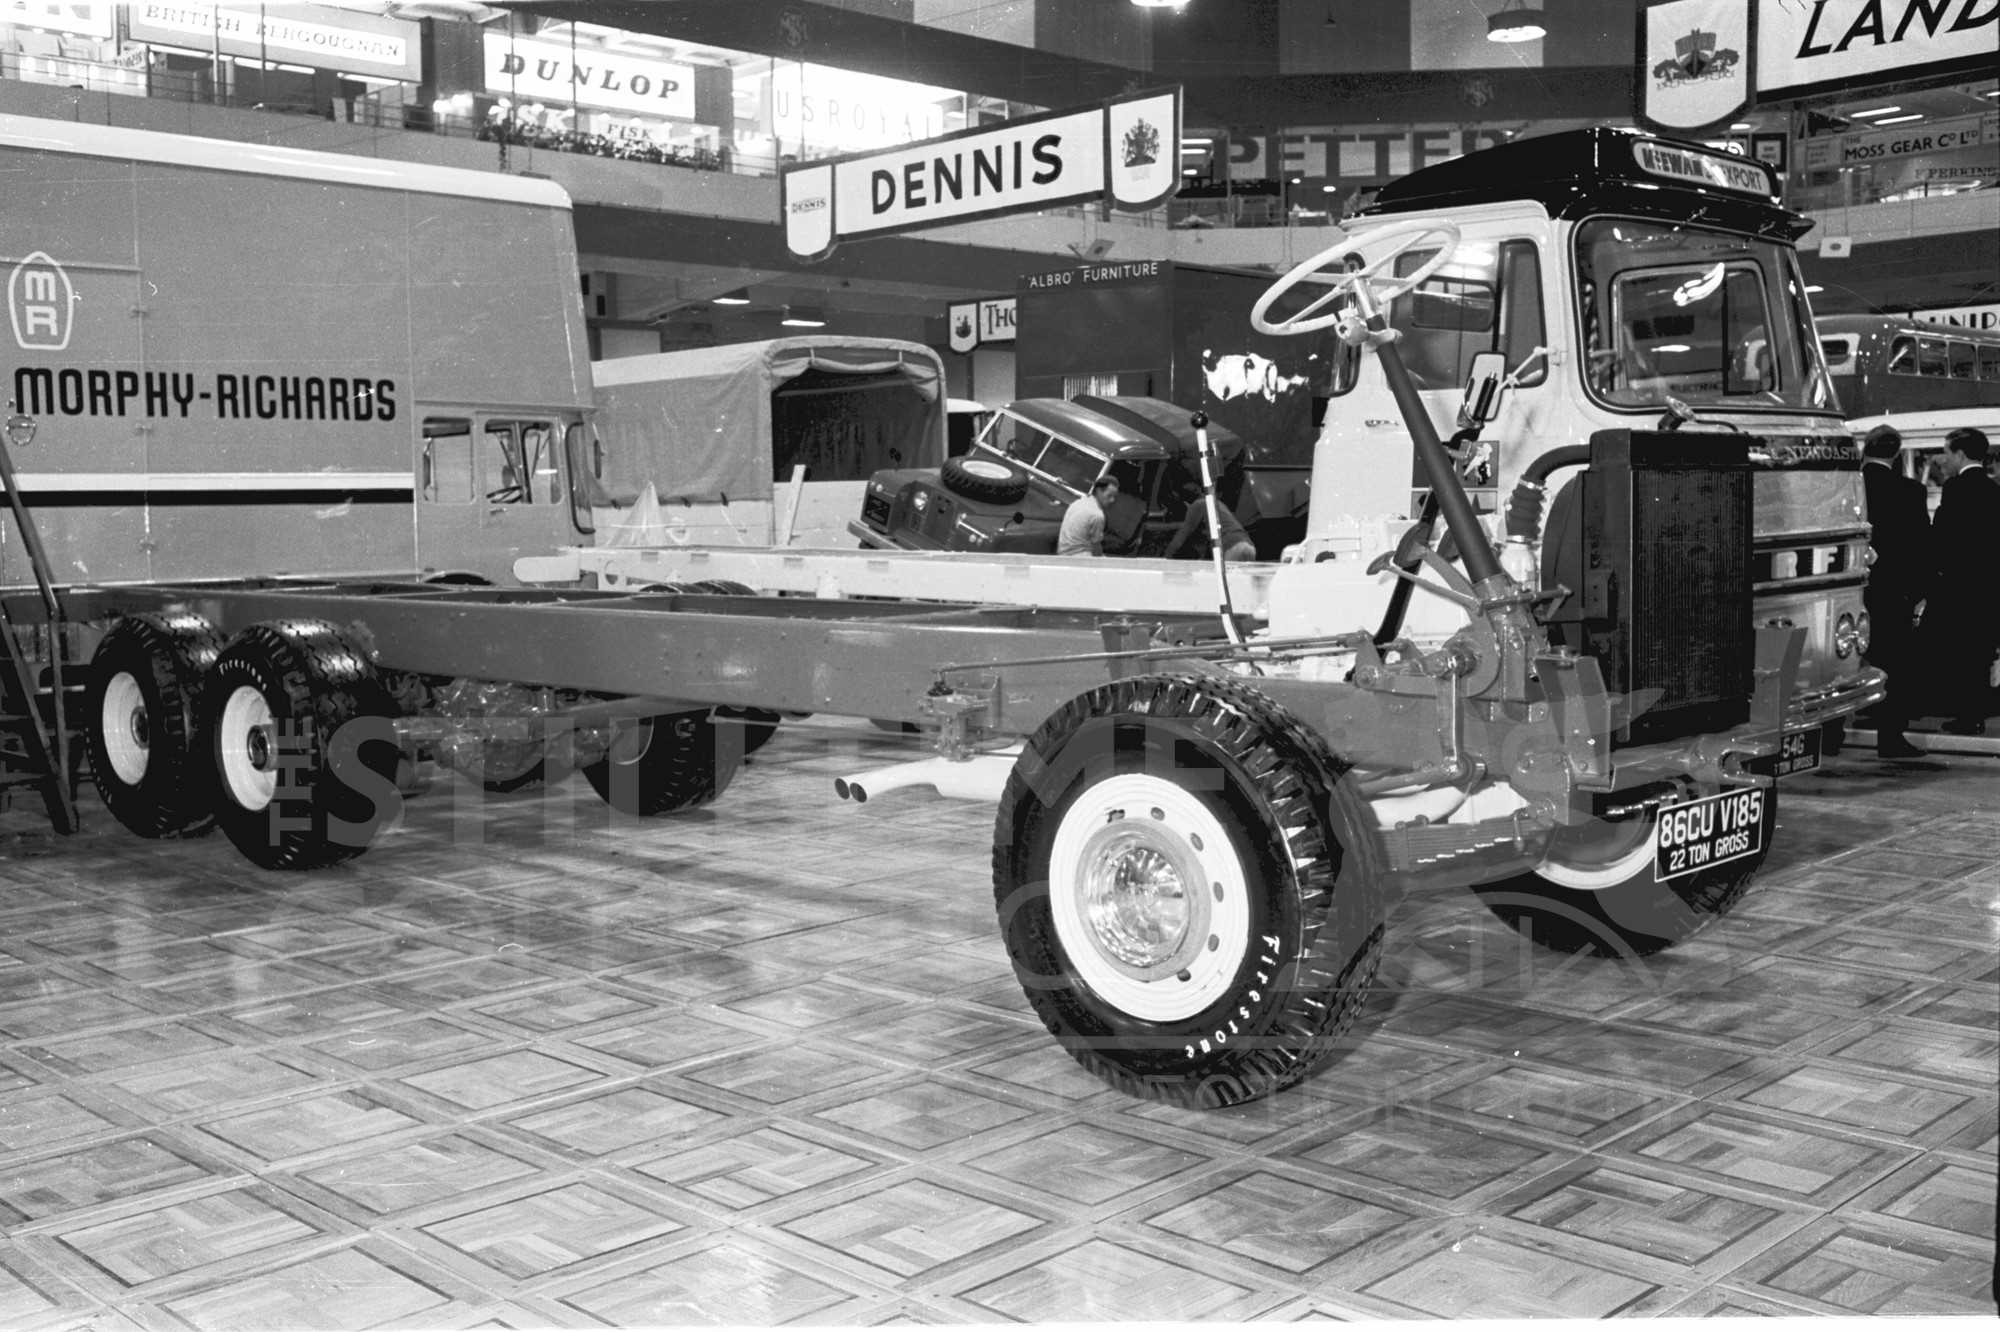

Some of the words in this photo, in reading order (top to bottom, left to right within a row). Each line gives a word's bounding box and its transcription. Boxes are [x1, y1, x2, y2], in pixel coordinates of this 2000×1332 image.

[146, 5, 240, 32] BRITISH
[499, 53, 680, 98] DUNLOP
[1845, 143, 1885, 160] MOSS
[1891, 137, 1932, 154] GEAR
[872, 134, 1063, 216] DENNIS
[1720, 164, 1763, 191] XPORT
[1083, 262, 1158, 282] FURNITURE
[14, 366, 396, 422] MORPHY-RICHARDS
[1771, 545, 1838, 579] RF
[1660, 802, 1714, 848] 86CU
[1720, 790, 1762, 832] V185
[1669, 849, 1686, 871] 22
[1688, 841, 1710, 867] TON
[1715, 830, 1749, 858] GROSS
[1184, 935, 1281, 1059] Firestone
